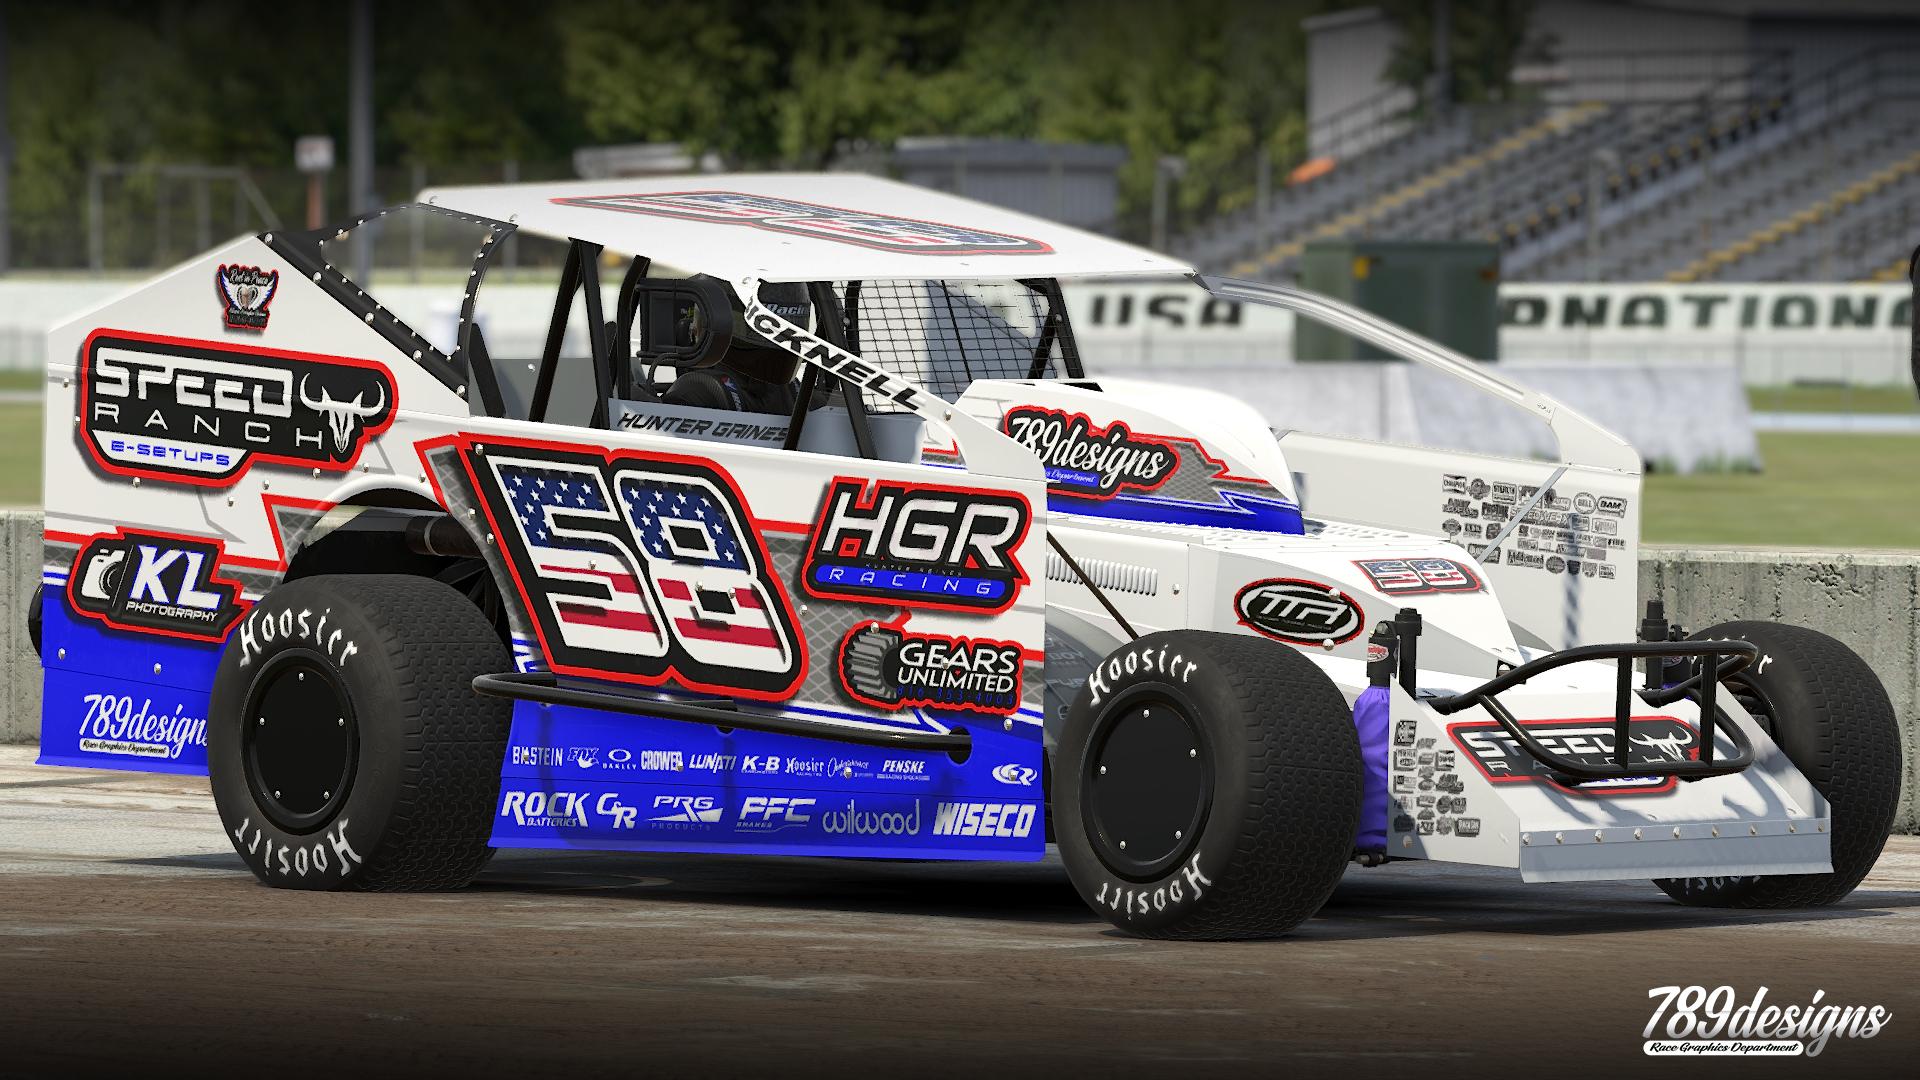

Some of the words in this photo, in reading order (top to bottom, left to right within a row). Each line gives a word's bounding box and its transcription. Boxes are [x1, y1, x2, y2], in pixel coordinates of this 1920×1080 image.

[1090, 295, 1242, 326] USA
[95, 346, 293, 418] SPEED
[94, 401, 323, 450] RANCH
[617, 412, 714, 435] HUNTER
[712, 421, 789, 442] GAINES
[110, 440, 230, 466] E-SETUPS
[1012, 417, 1170, 489] 789designs
[822, 491, 1020, 567] HGR
[130, 545, 222, 609] KL
[485, 455, 793, 673] 58
[1360, 560, 1468, 588] 58
[828, 568, 992, 594] RACING
[125, 600, 218, 622] PHOTOGRAPHY
[239, 608, 358, 667] Hoosier
[899, 643, 1016, 674] GEARS
[897, 667, 1014, 693] UNLIMITED
[1088, 644, 1197, 706] Hoosier
[641, 750, 683, 771] CROWER
[688, 753, 737, 773] LUNATI
[742, 755, 781, 771] K-B
[882, 759, 925, 774] PENSKE
[501, 791, 591, 828] ROCK
[739, 797, 816, 822] PFC
[822, 799, 920, 836] wilwood
[932, 802, 1036, 837] WISECO
[527, 817, 577, 827] BATTERIES
